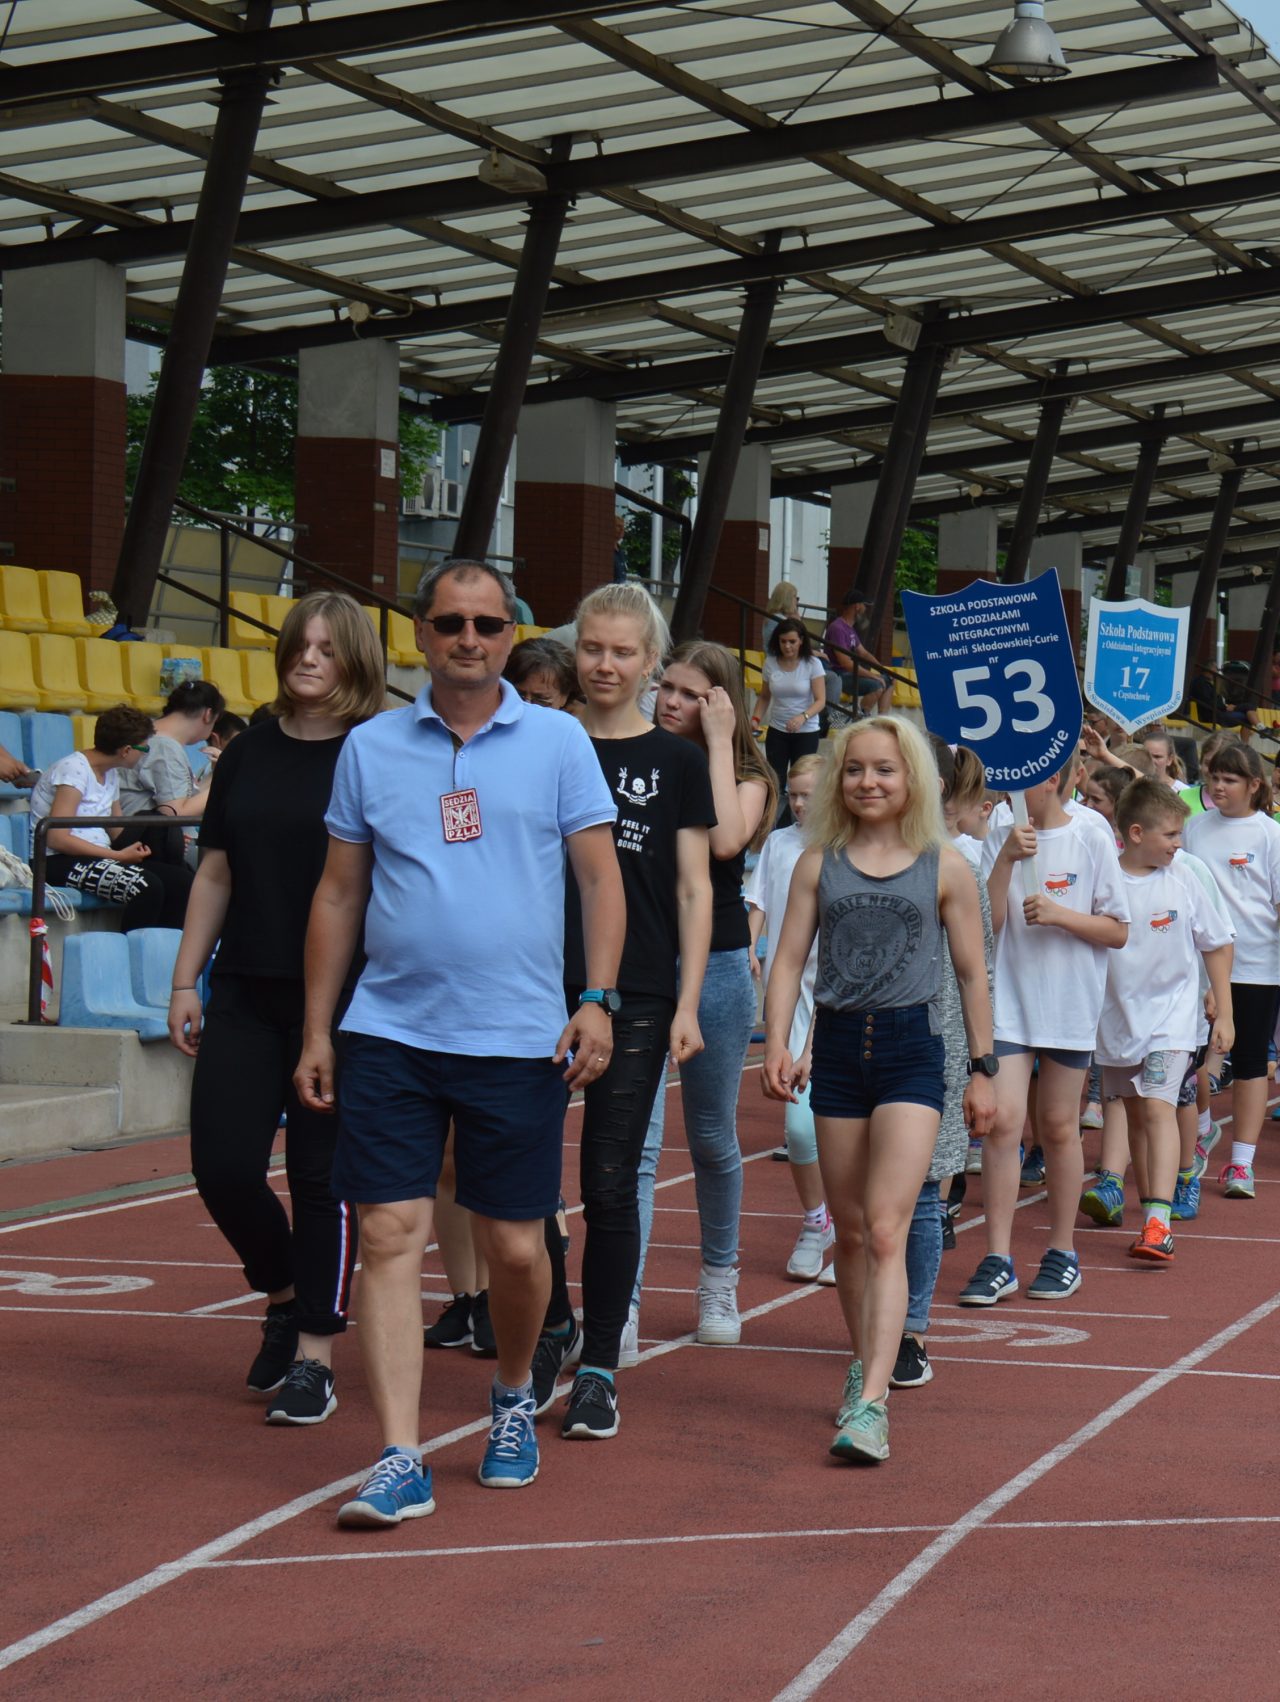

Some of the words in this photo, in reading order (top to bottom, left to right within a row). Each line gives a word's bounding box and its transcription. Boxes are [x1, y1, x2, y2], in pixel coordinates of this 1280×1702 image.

[930, 602, 966, 616] SZKOŁA
[967, 592, 1038, 611] PODSTAWOWA
[952, 618, 959, 627] Z
[960, 609, 1021, 627] ODDZIAŁAMI
[948, 622, 1030, 642] INTEGRACYJNYMI
[1100, 622, 1126, 638] Szkoła
[1127, 625, 1175, 643] Podstawowa
[926, 650, 942, 660] im.
[943, 646, 969, 658] Marii
[971, 633, 1060, 654] Skłodowskiej-Curie
[1134, 643, 1172, 656] Integracyjnymi
[988, 656, 999, 664] nr
[1120, 666, 1151, 690] 17
[952, 658, 1055, 740] 53
[1117, 690, 1151, 702] Częstochowie
[985, 729, 1069, 782] ęstochowie
[448, 826, 478, 838] PZLA
[621, 819, 640, 831] FEEL
[641, 824, 651, 834] IT
[622, 829, 632, 839] IN
[632, 832, 644, 842] MY
[827, 896, 864, 923] STATE
[868, 895, 903, 909] NEW
[903, 904, 920, 940] YORK
